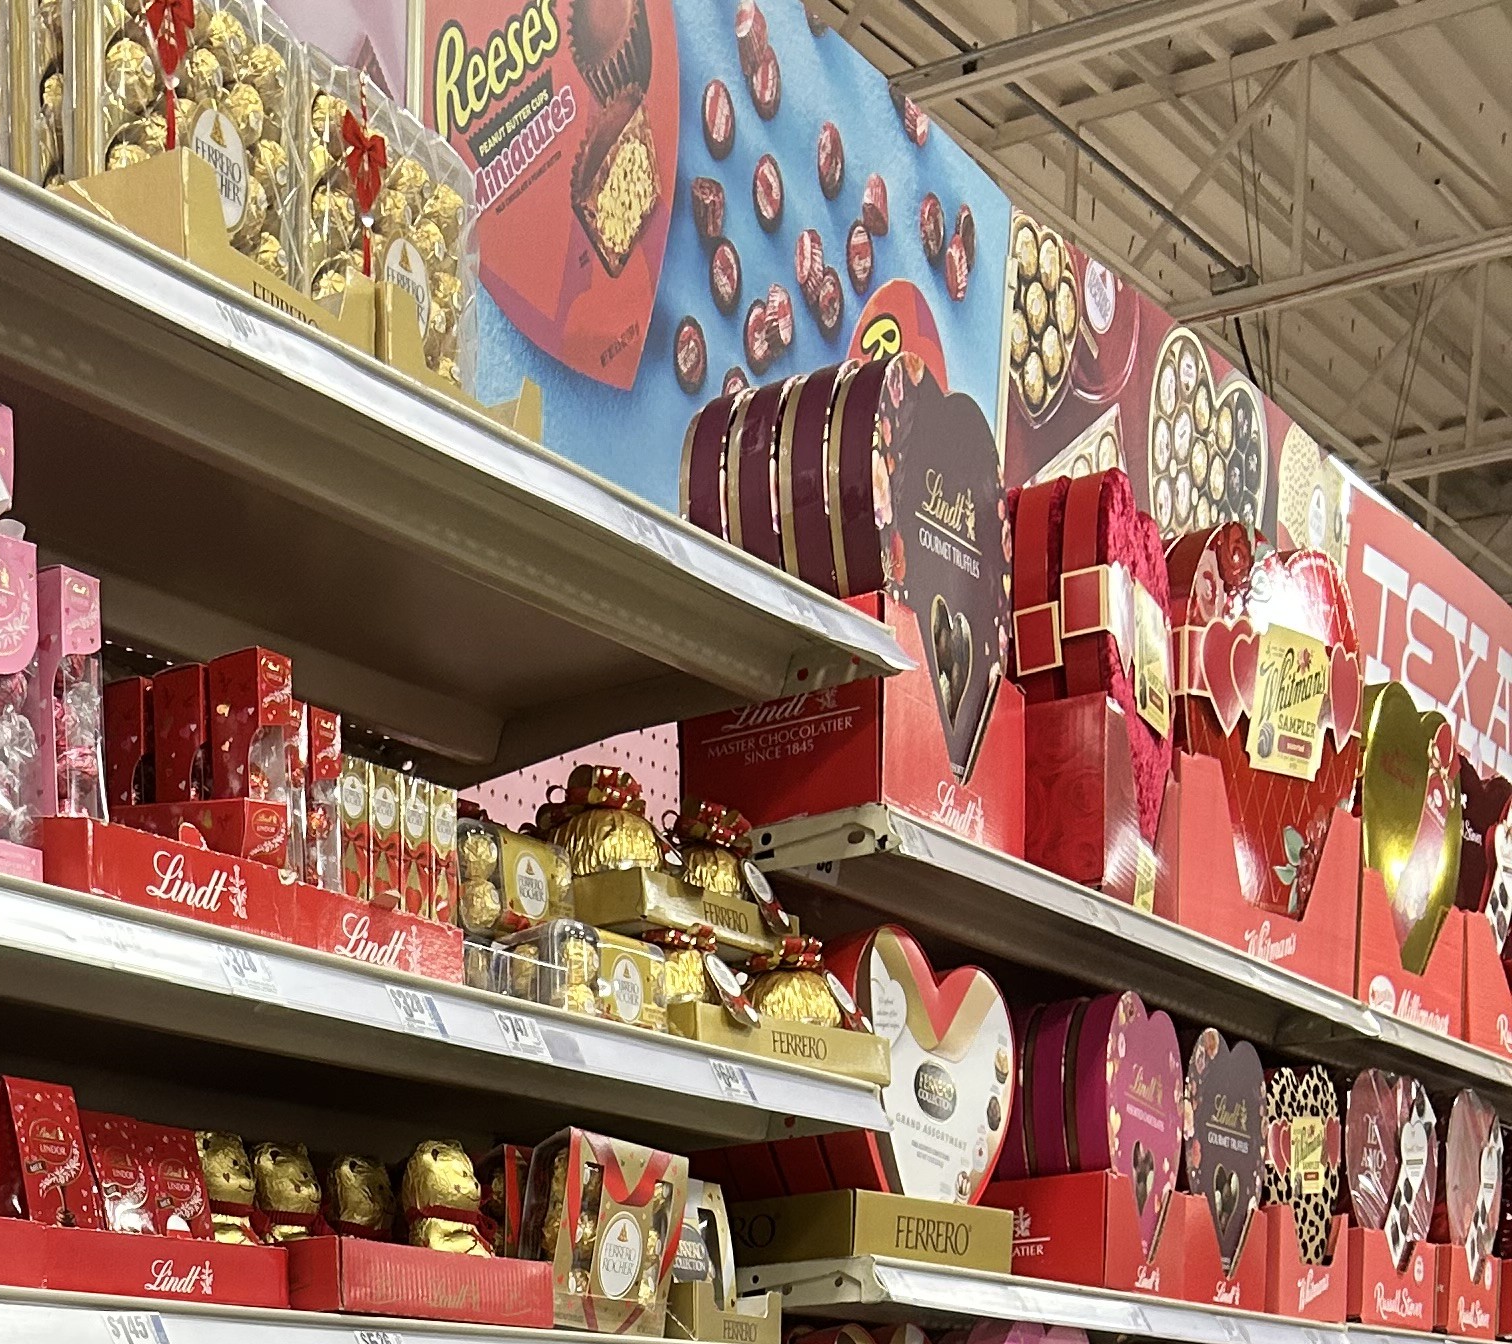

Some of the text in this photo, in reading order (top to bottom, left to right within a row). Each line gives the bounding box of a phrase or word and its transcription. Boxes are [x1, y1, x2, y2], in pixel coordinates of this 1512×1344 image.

[478, 125, 506, 157] PEANUT
[506, 107, 532, 134] BUTTER
[919, 527, 979, 579] GOURMET TRUFFLES
[707, 715, 853, 759] MASTER CHOCOLATIER
[1277, 713, 1316, 738] SAMPLER
[744, 741, 815, 766] SINCE 1845
[703, 901, 749, 933] FERRERO
[771, 1030, 828, 1060] FERRERO
[895, 1215, 969, 1256] FERRERO
[144, 1259, 200, 1294] Lindt
[601, 1257, 635, 1278] ROCHER
